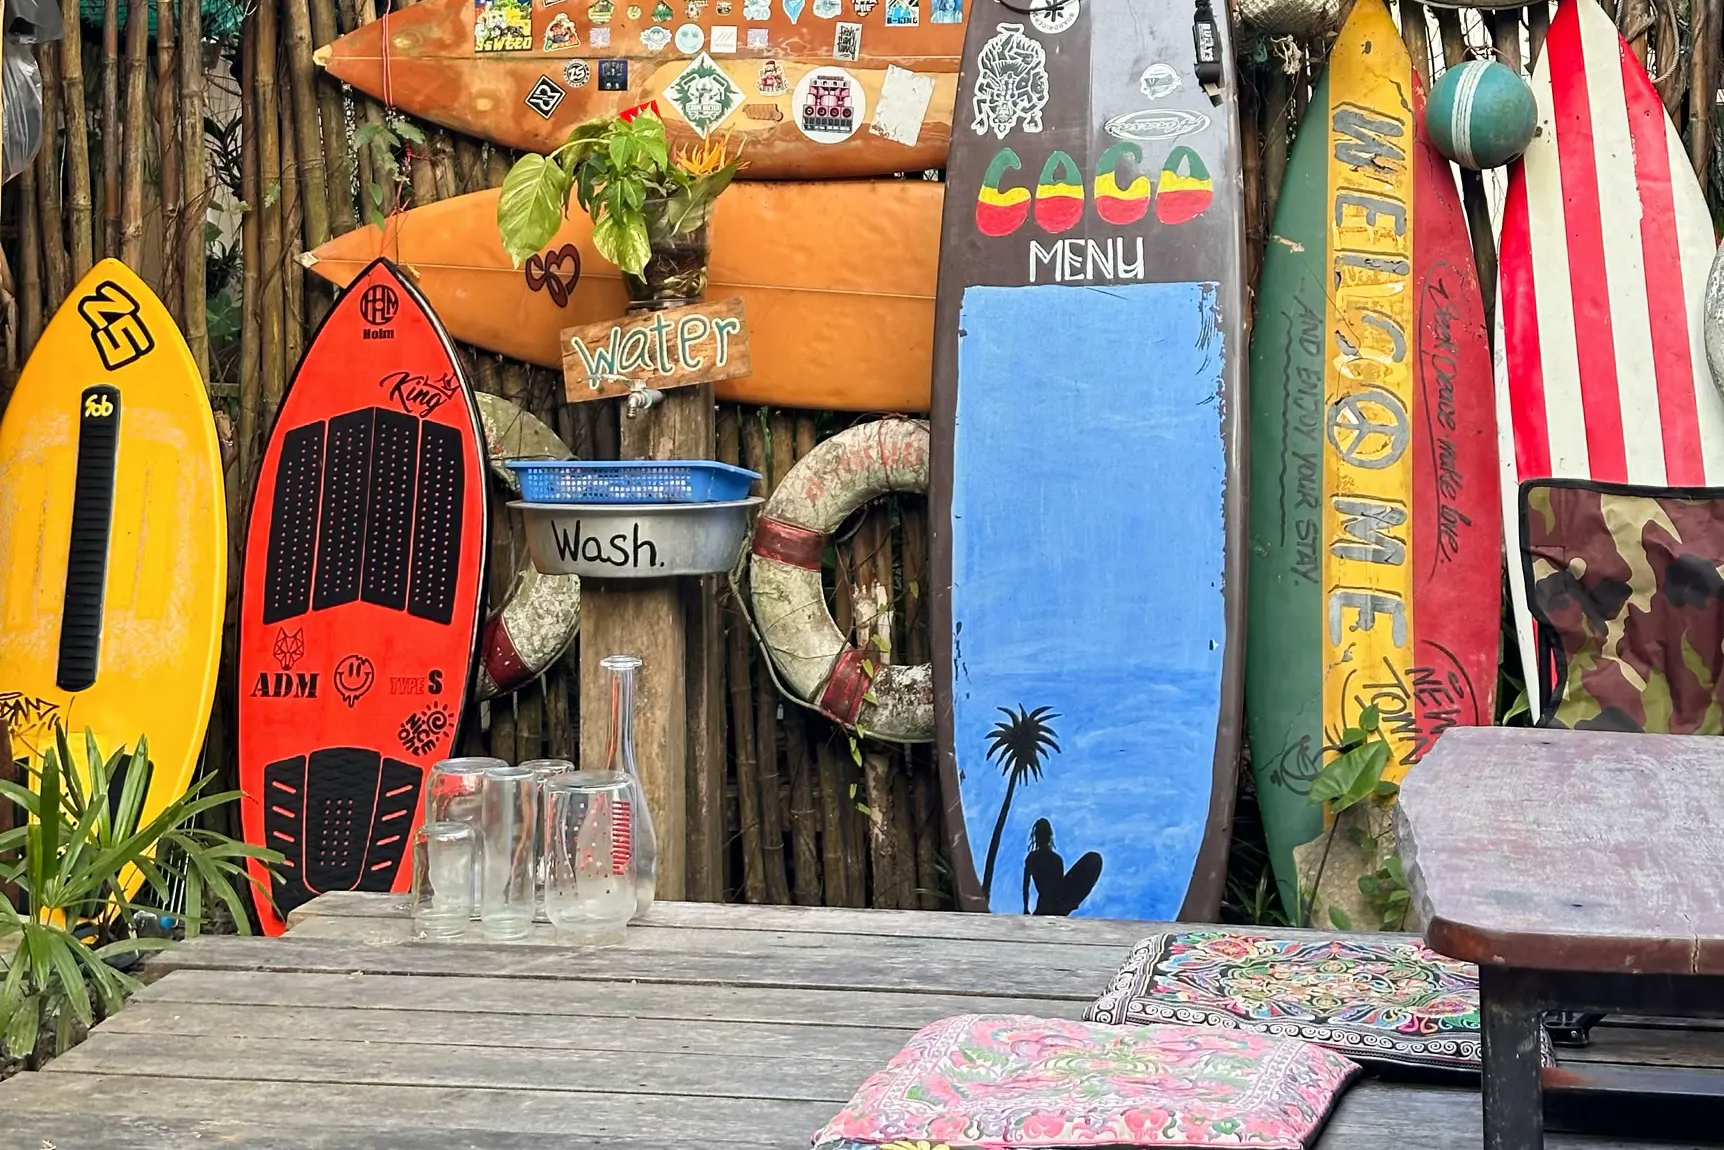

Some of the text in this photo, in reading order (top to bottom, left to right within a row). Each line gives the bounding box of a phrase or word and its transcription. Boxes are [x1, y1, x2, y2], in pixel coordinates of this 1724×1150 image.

[1029, 237, 1145, 283] MENU
[363, 328, 395, 340] Holm
[379, 371, 448, 418] King
[1293, 368, 1322, 445] ENJOY
[1292, 451, 1321, 513] YOUR
[1290, 518, 1320, 588] STAY.
[250, 672, 320, 699] ADM
[389, 669, 443, 695] TYPE S
